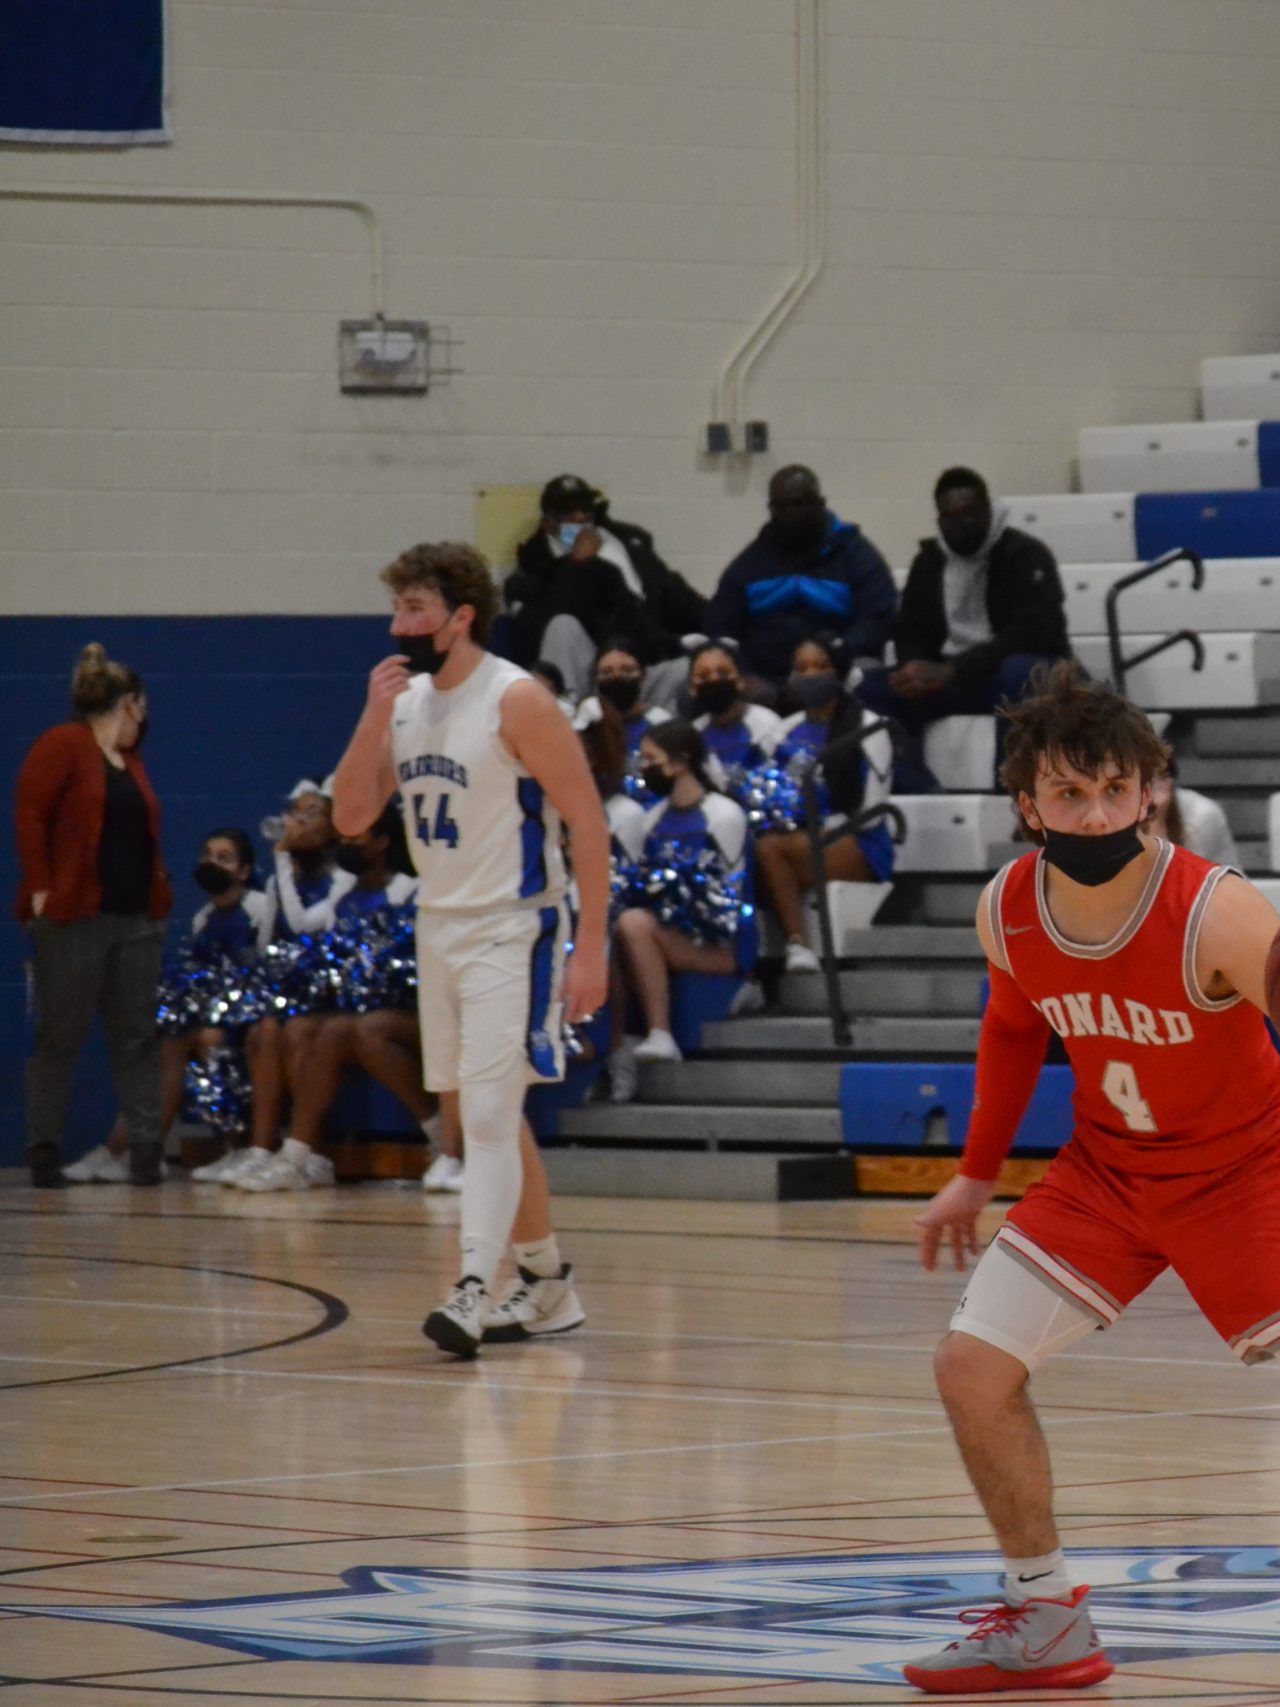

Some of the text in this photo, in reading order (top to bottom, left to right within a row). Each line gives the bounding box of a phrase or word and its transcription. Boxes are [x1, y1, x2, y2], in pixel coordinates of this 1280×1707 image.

[413, 793, 460, 849] 44
[1032, 992, 1195, 1046] ONARD
[1102, 1060, 1159, 1133] 4
